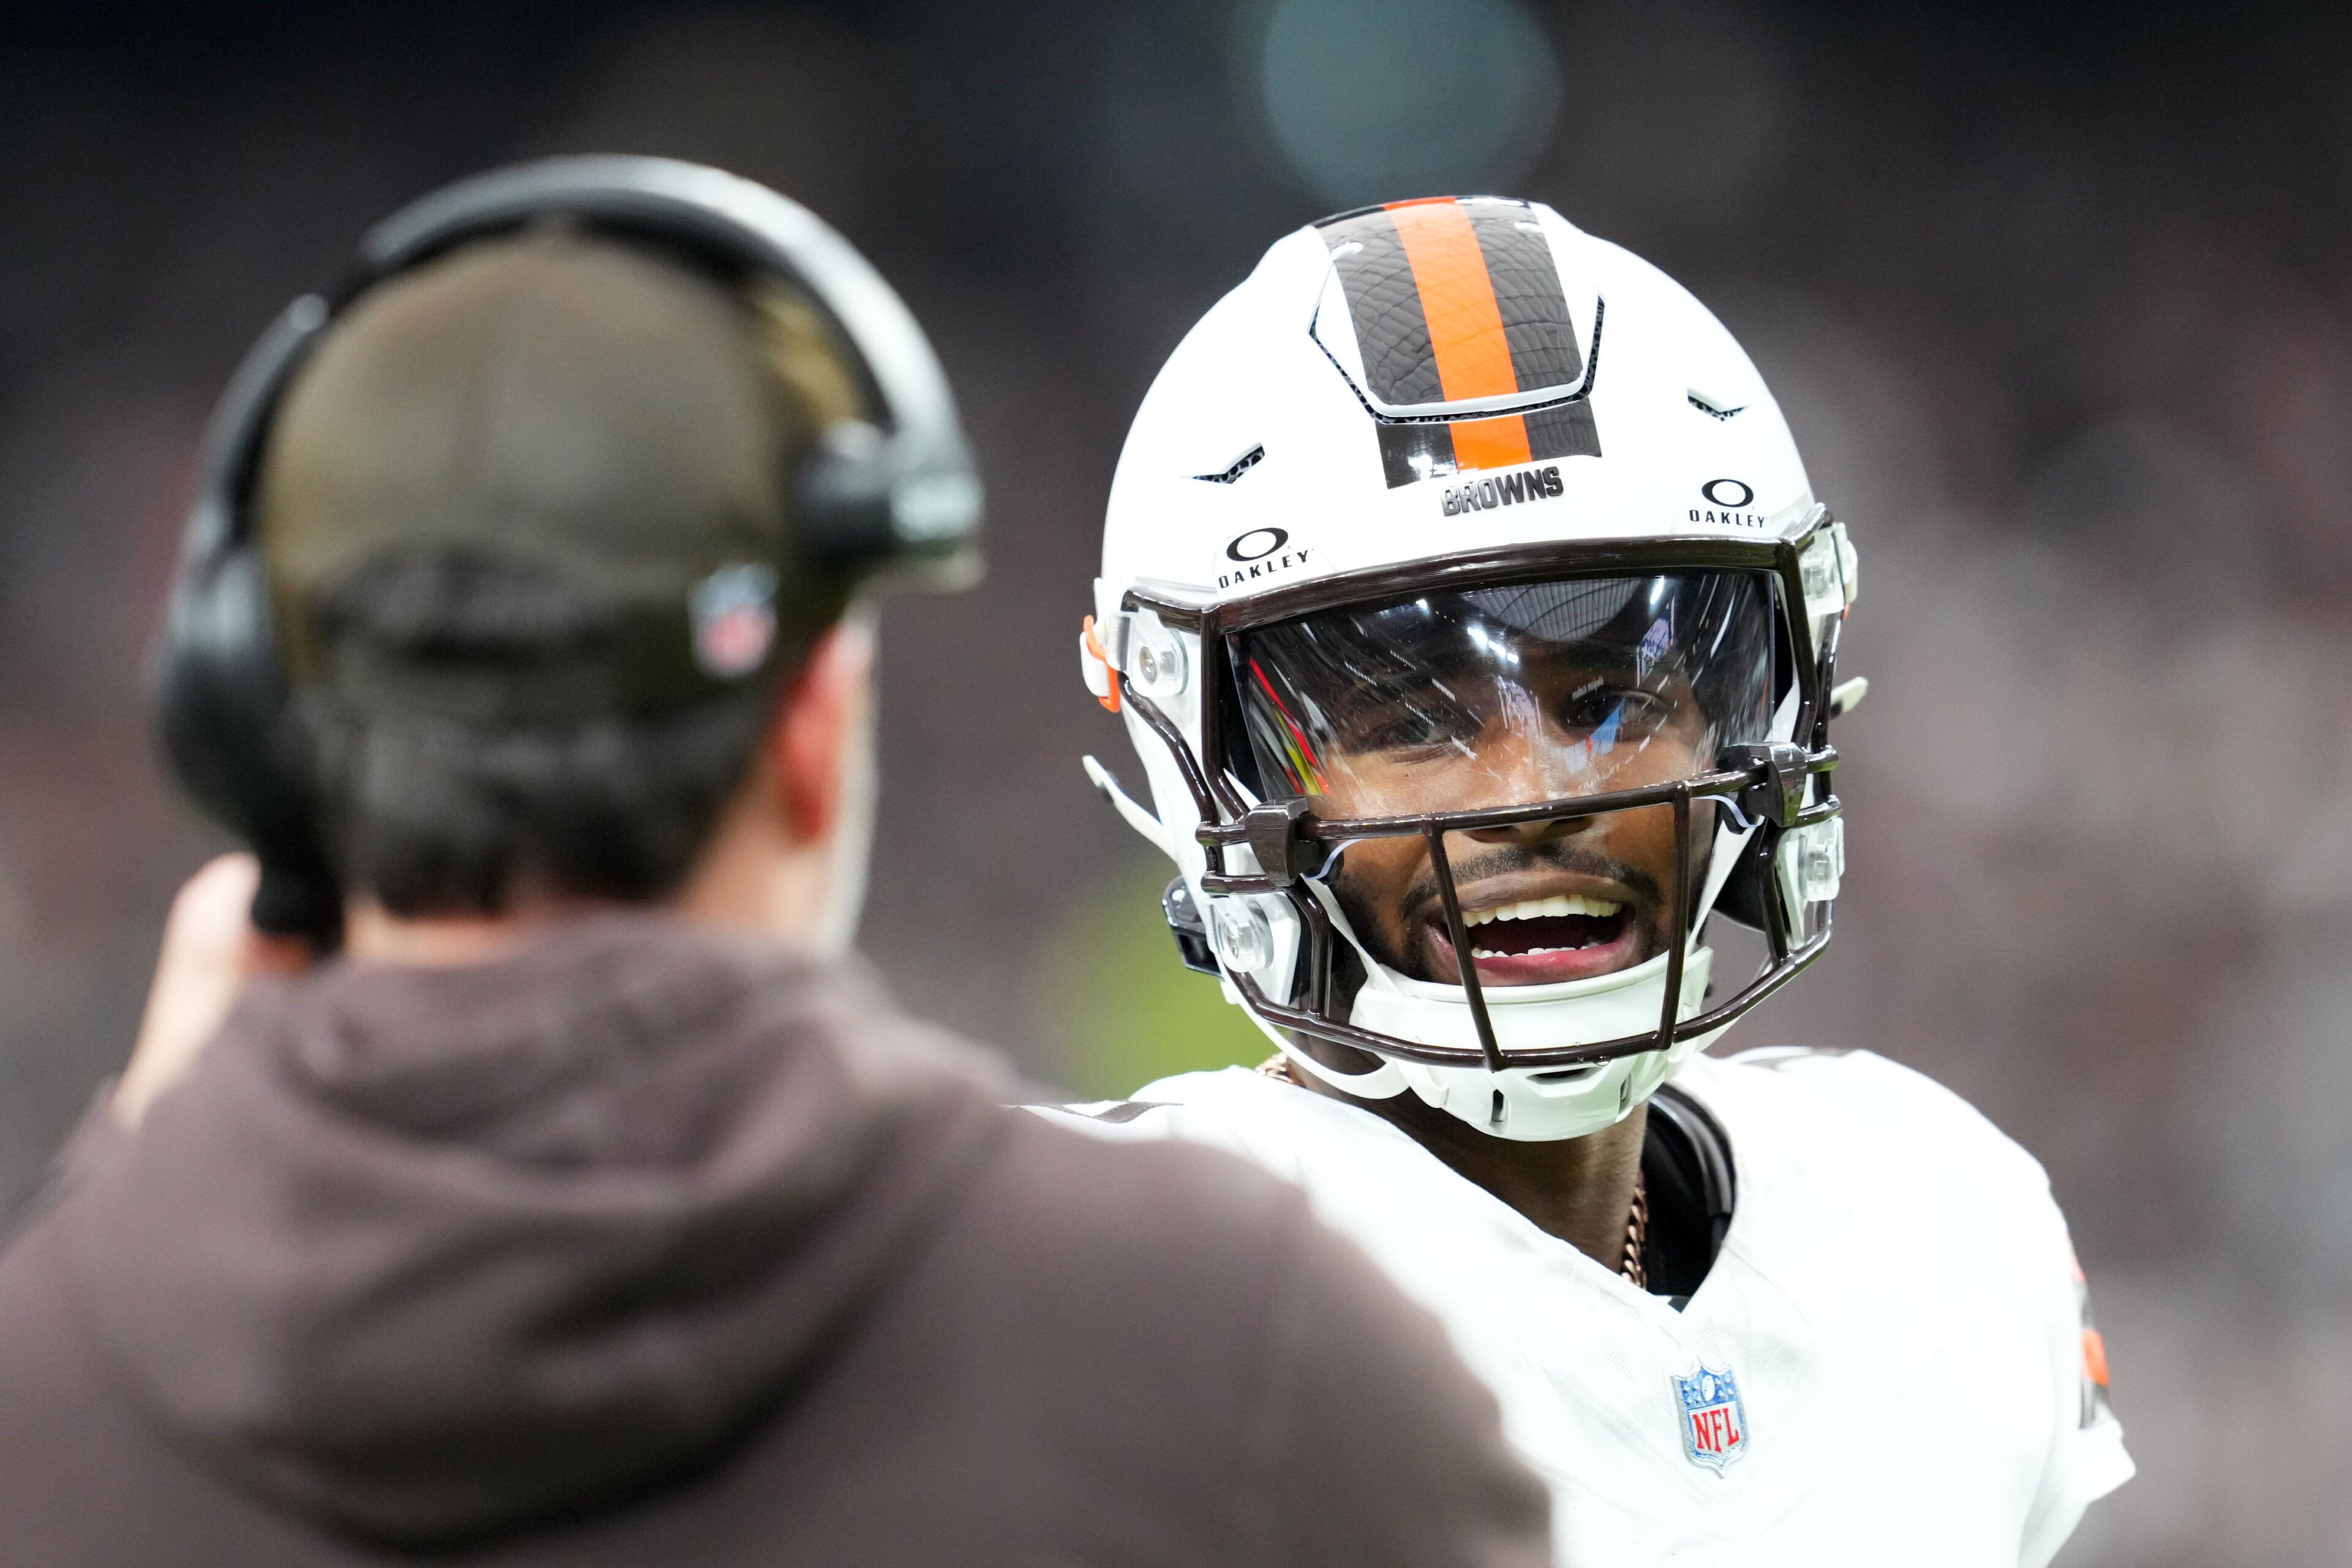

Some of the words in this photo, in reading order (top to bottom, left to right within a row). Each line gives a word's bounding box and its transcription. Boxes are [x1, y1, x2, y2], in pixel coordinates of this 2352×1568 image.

[1441, 466, 1564, 516] BROWNS
[1689, 509, 1765, 528] OAKLEY
[1218, 549, 1309, 589] OAKLEY
[1692, 1407, 1740, 1453] NFL
